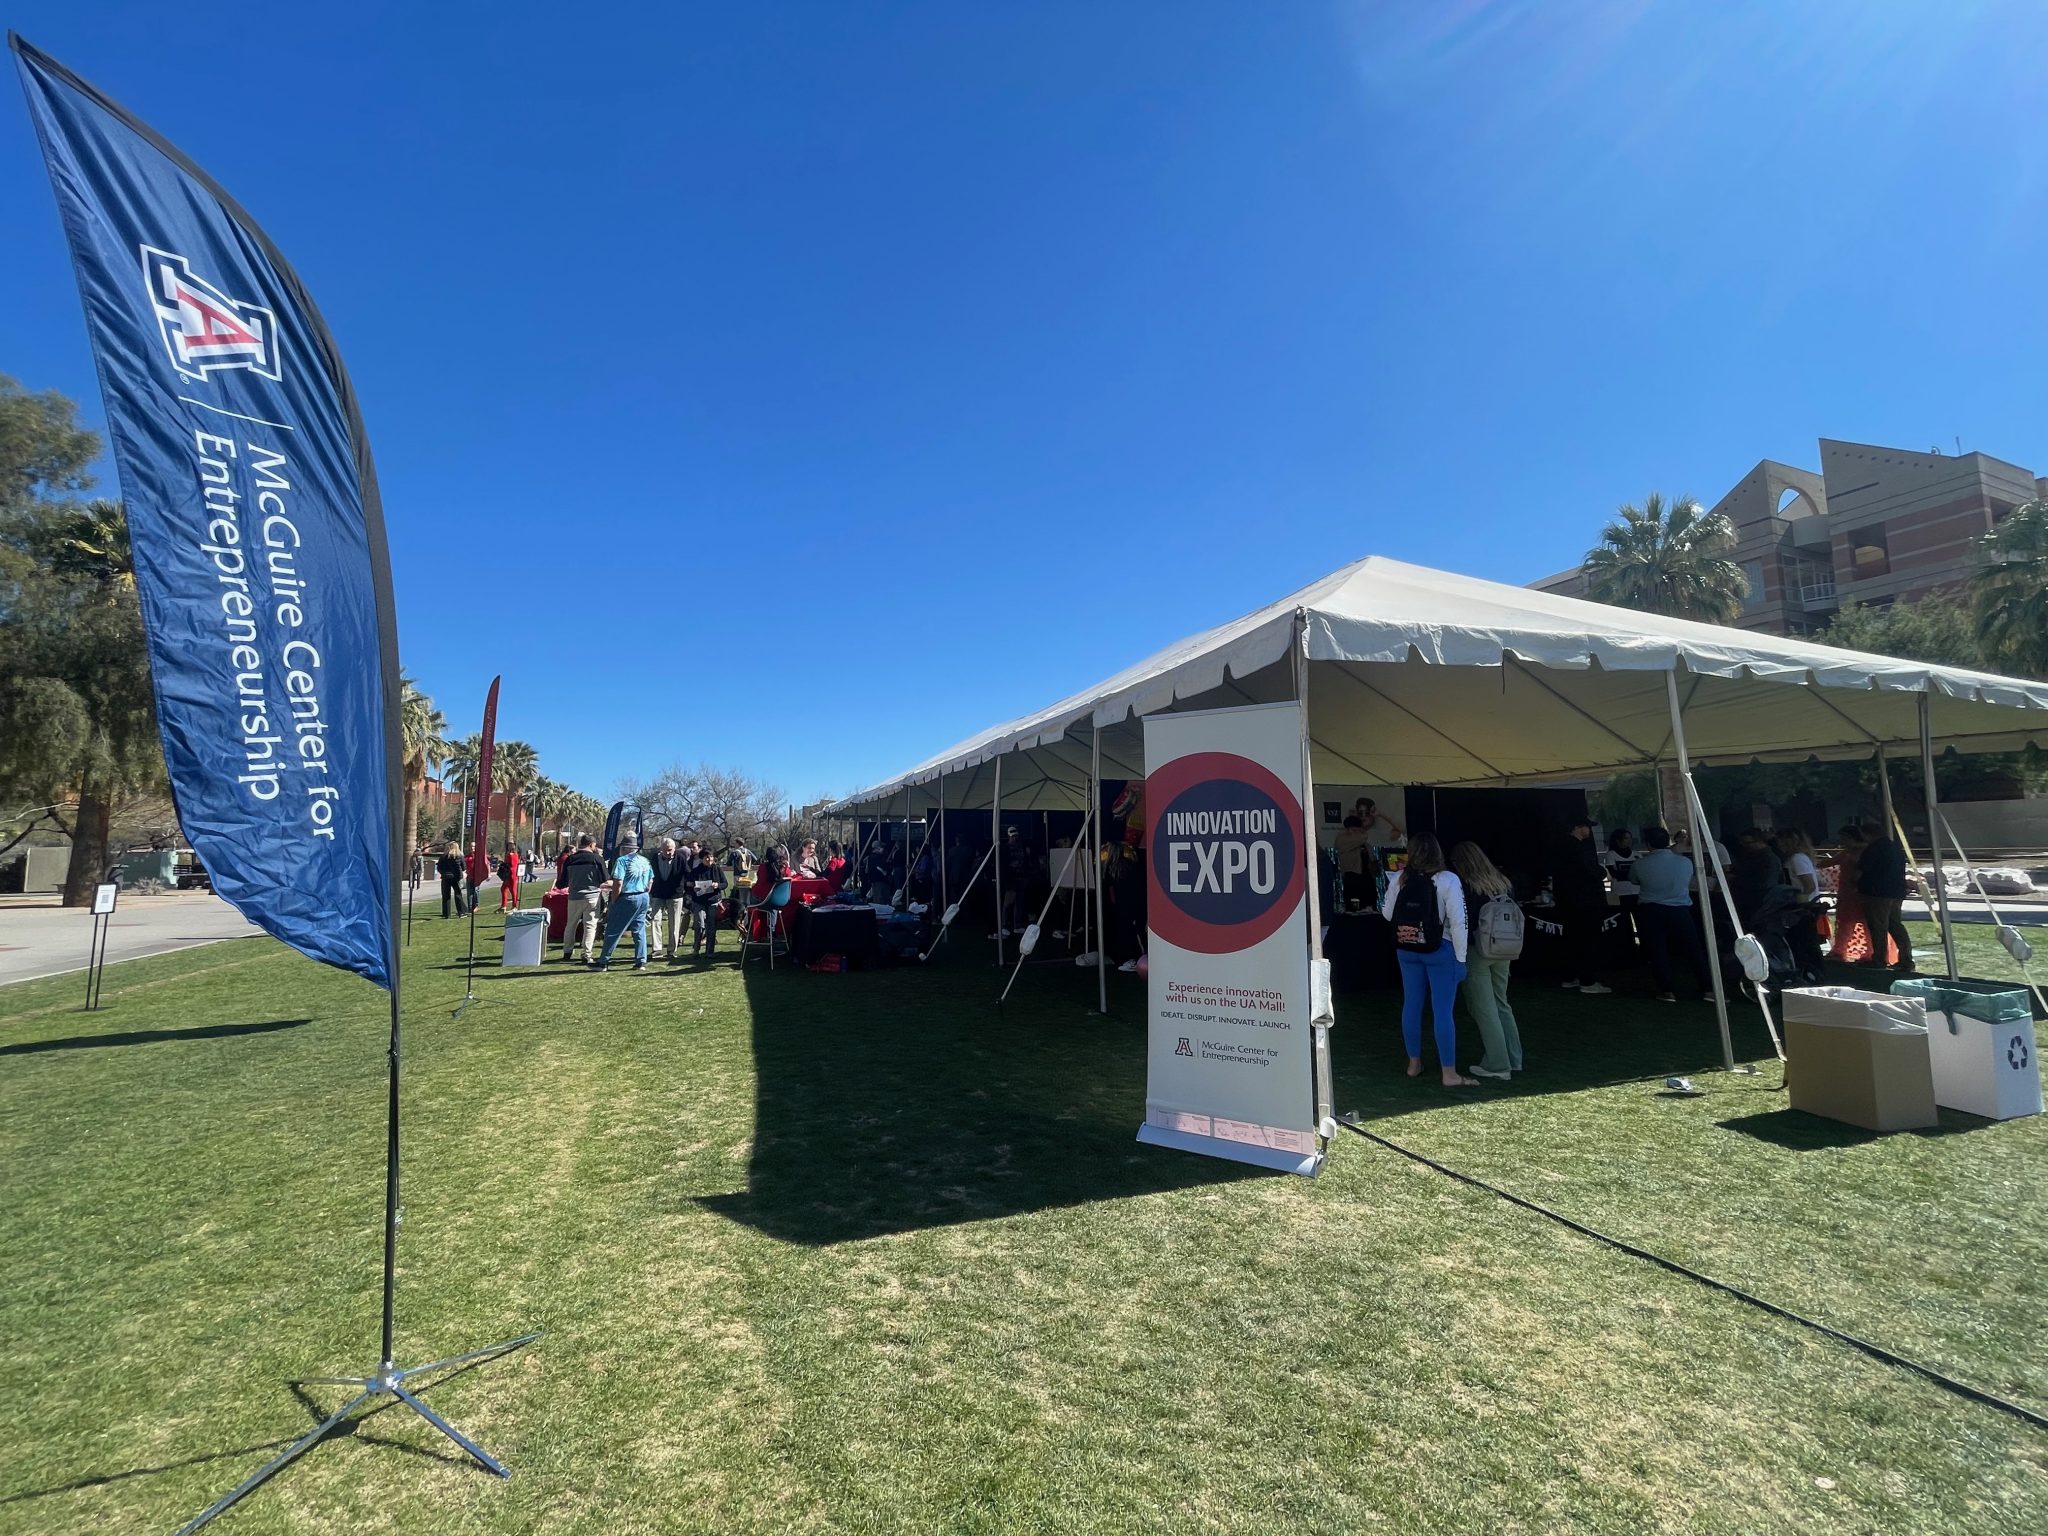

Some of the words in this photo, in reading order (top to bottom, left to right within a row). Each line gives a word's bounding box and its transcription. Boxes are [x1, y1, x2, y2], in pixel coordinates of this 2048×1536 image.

[195, 429, 286, 801] Entrepreneurship
[247, 442, 307, 627] McGuire
[283, 640, 329, 774] Center
[307, 785, 340, 840] for
[1167, 808, 1276, 836] INNOVATION
[1169, 840, 1275, 895] EXPO
[1168, 981, 1223, 995] Experience
[1226, 986, 1282, 1000] innovation
[1166, 992, 1188, 1004] with
[1191, 997, 1201, 1005] us
[1204, 998, 1217, 1006] on
[1220, 998, 1237, 1008] the
[1240, 999, 1256, 1010] UA
[1259, 1001, 1286, 1012] Mall!
[1161, 1011, 1186, 1020] IDEATE.
[1187, 1013, 1217, 1023] DISRUPT.
[1218, 1017, 1257, 1027] INNOVATE.
[1202, 1041, 1235, 1053] McGuire
[1237, 1045, 1265, 1056] Center
[1267, 1048, 1279, 1057] for
[1202, 1051, 1270, 1068] Entrepreneurship
